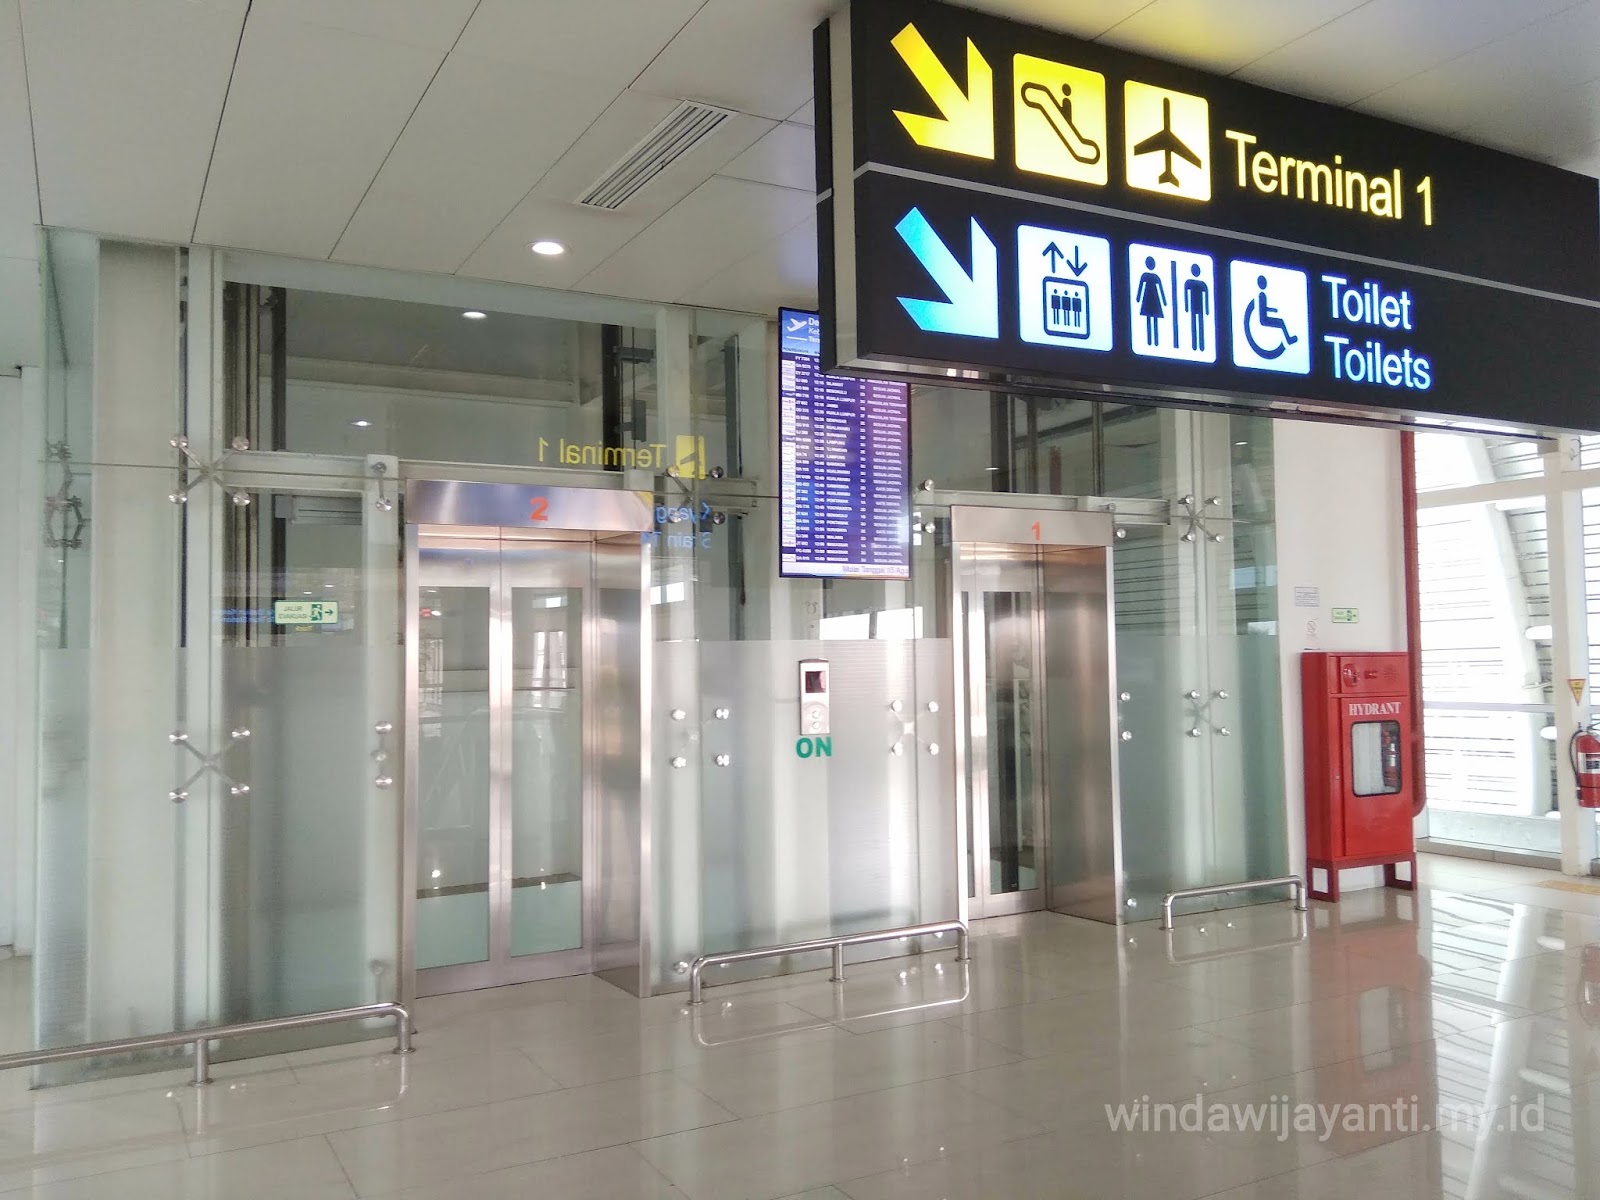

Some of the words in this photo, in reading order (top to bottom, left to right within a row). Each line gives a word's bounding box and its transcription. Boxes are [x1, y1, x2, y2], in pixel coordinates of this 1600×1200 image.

[1225, 129, 1403, 220] Terminal
[1415, 176, 1434, 226] 1
[1322, 275, 1412, 331] Toilet
[1325, 335, 1432, 391] Toilets
[530, 497, 549, 522] 2
[1031, 520, 1041, 541] 1
[1349, 702, 1401, 716] HYDRANT
[796, 736, 832, 759] ON
